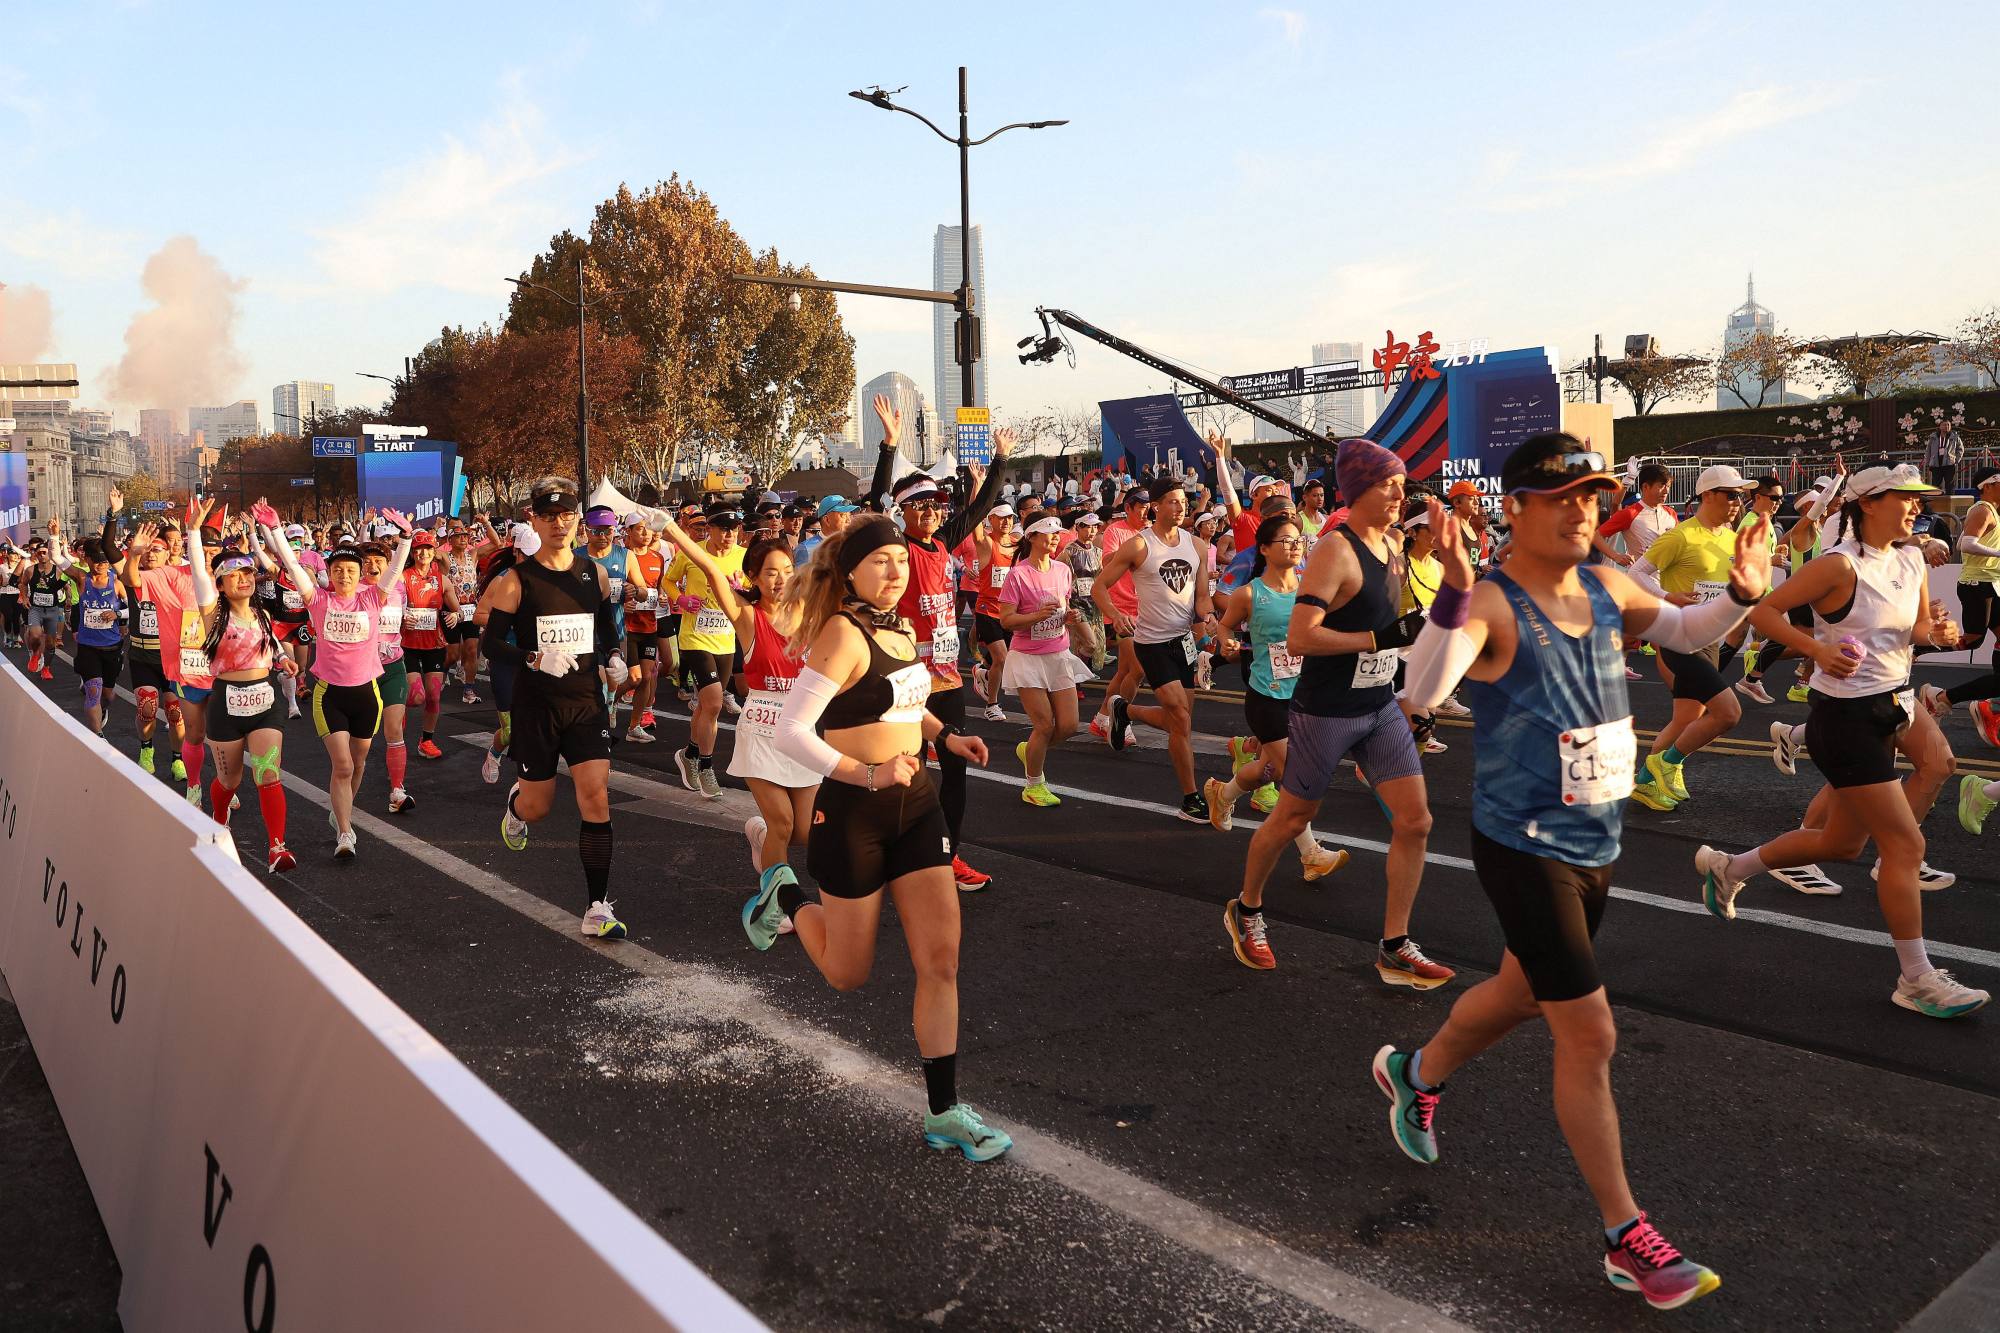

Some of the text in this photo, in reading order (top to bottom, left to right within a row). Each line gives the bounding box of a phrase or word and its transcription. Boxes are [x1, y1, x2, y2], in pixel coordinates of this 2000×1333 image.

[1235, 378, 1253, 389] 2025
[374, 442, 414, 452] START
[1442, 459, 1480, 477] RUN
[326, 620, 361, 633] C33079
[541, 627, 585, 644] C21302
[229, 692, 266, 707] C32667
[43, 856, 126, 1025] VOLVO
